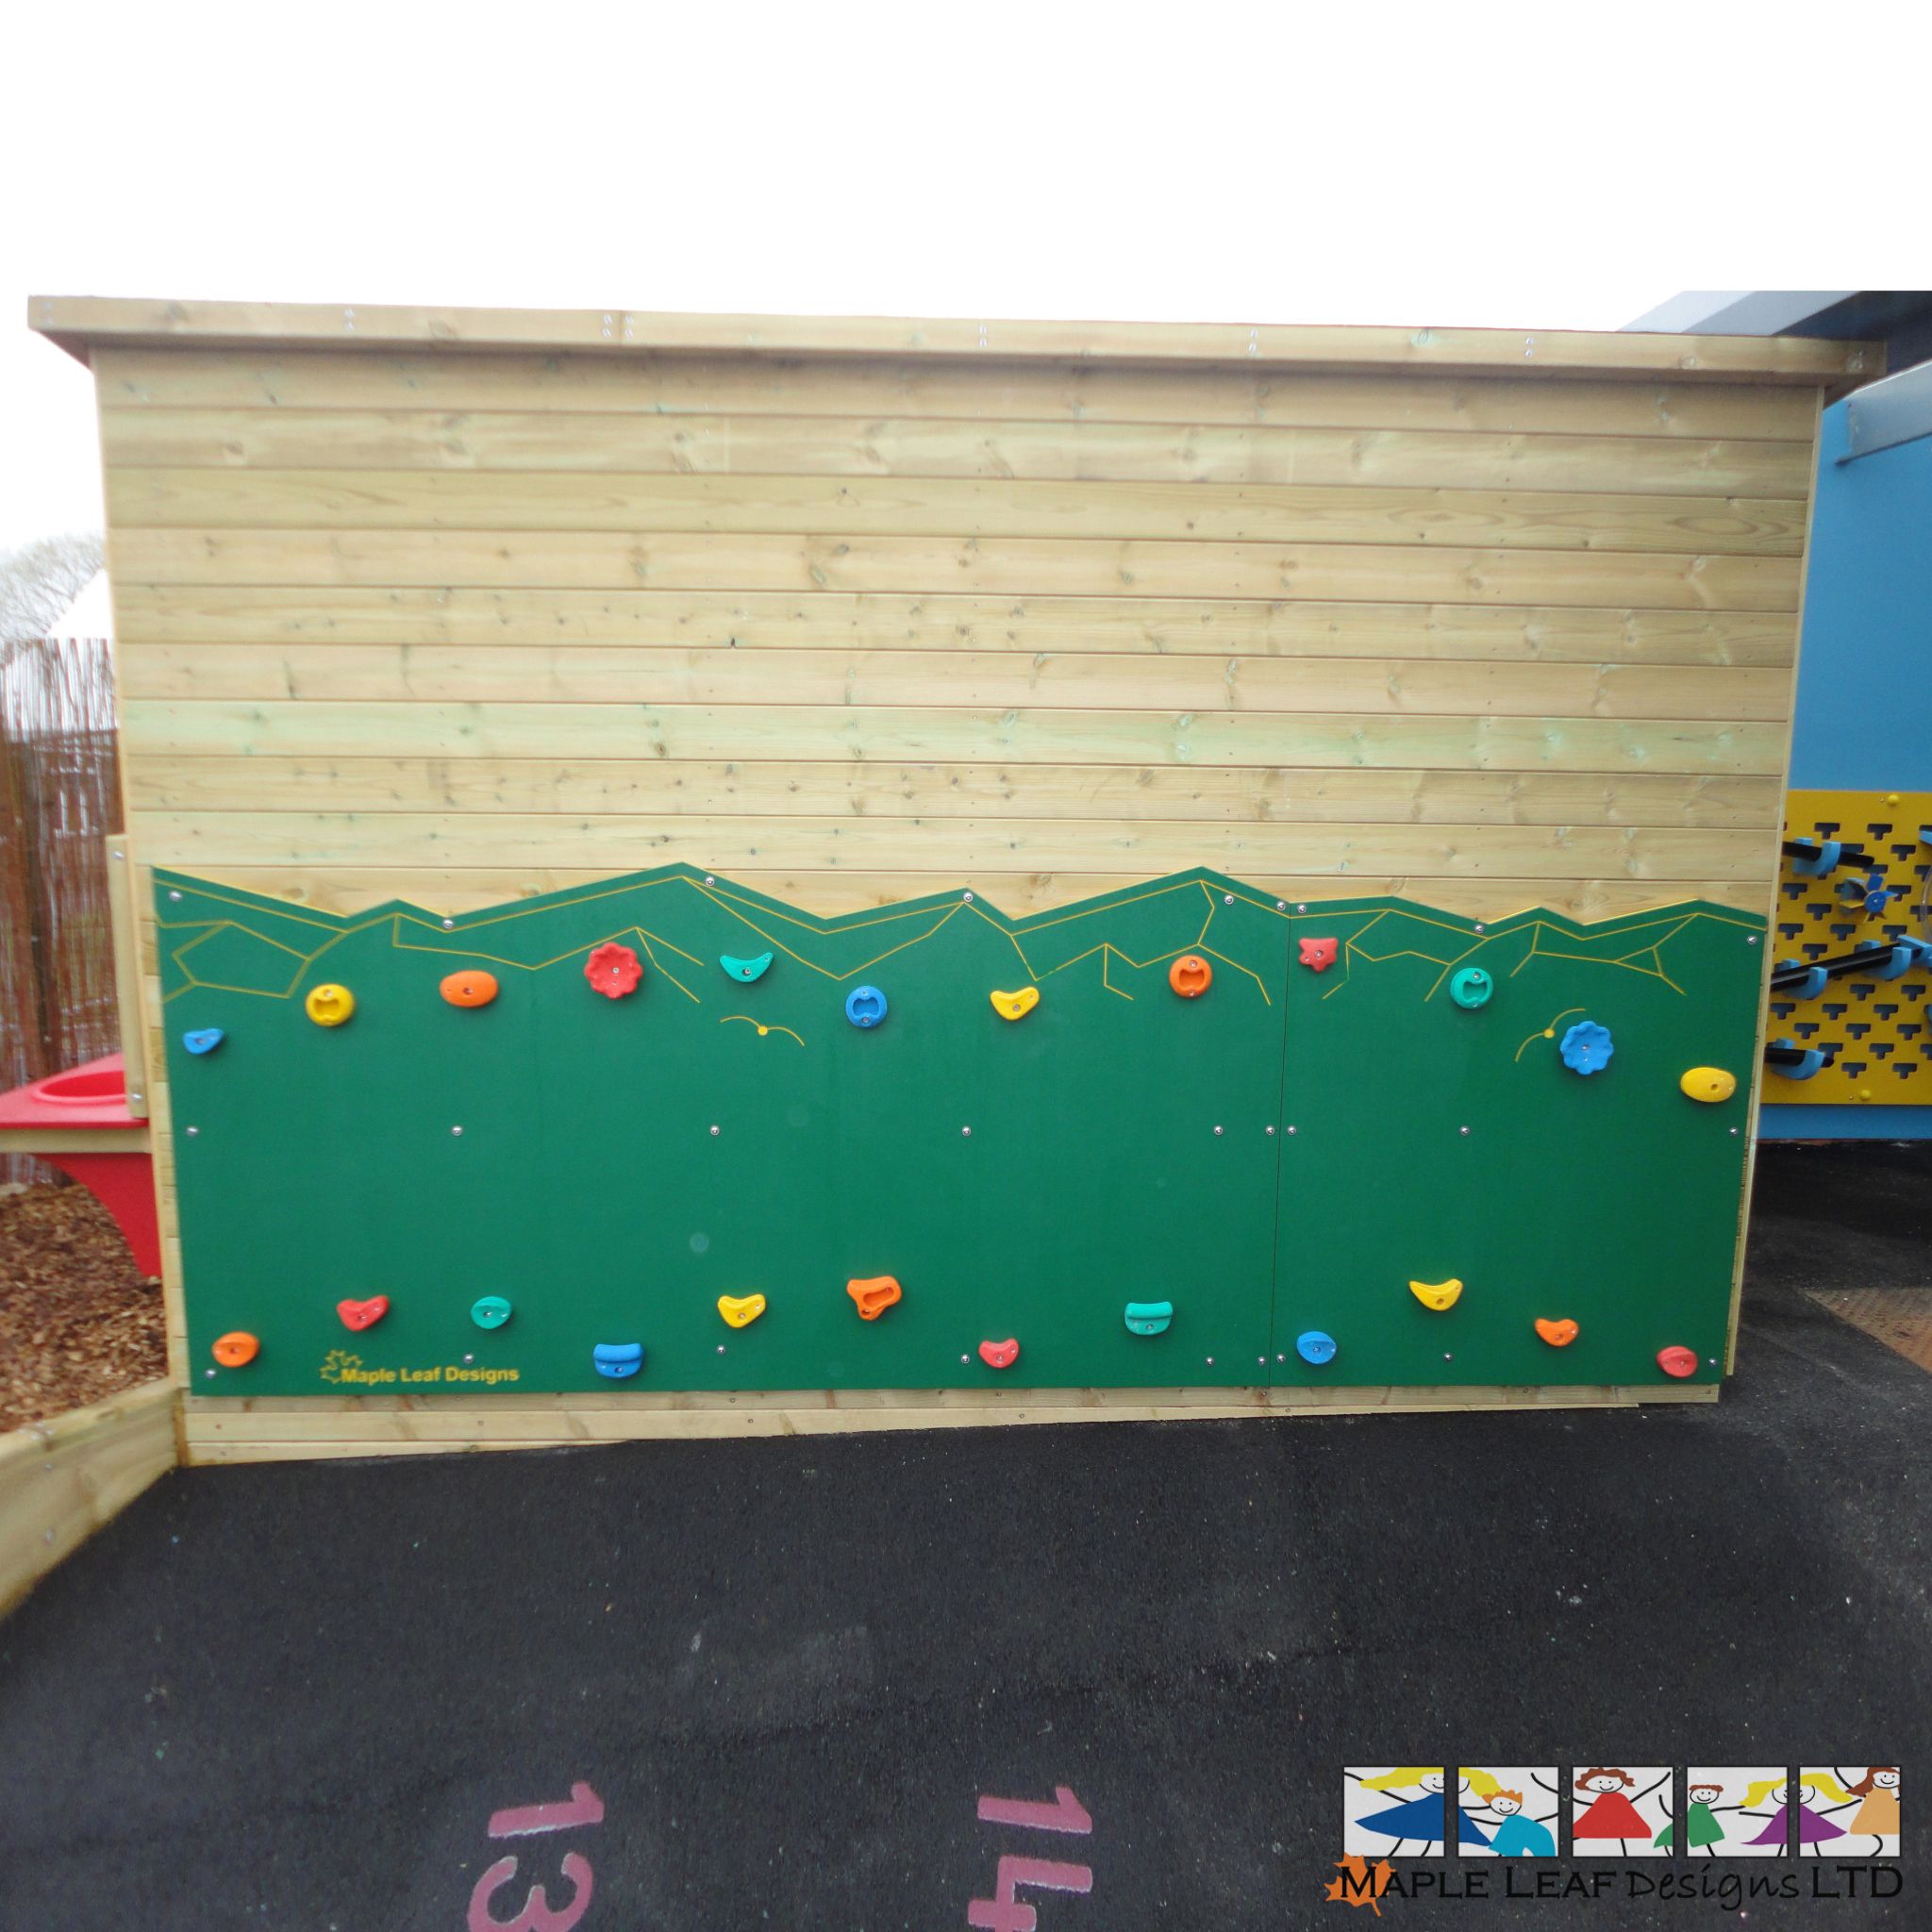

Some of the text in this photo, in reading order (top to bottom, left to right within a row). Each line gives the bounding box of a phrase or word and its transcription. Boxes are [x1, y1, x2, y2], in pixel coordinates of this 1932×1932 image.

[341, 1366, 520, 1386] Maple Leaf Designs
[469, 1782, 604, 1932] 13
[968, 1786, 1092, 1932] 14
